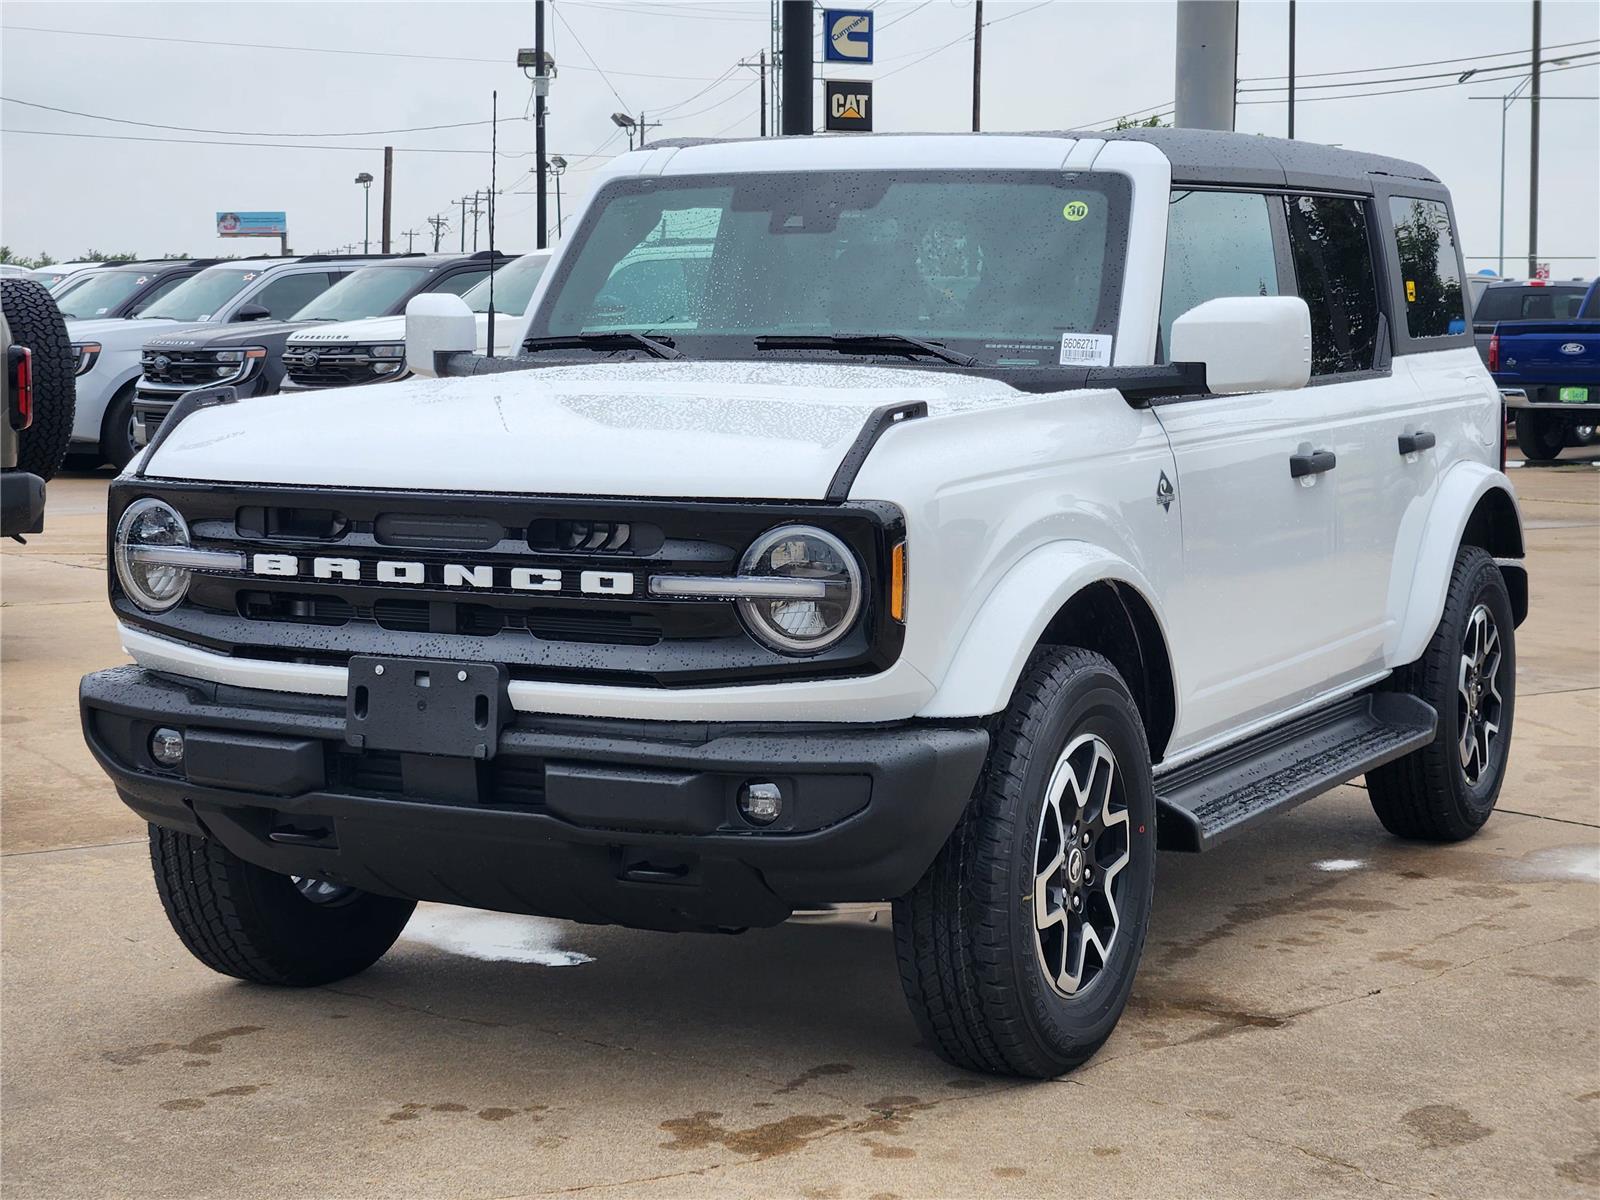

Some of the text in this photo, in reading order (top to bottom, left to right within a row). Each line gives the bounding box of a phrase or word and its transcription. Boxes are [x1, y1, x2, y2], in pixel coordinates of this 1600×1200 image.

[832, 16, 866, 41] Cummins
[831, 93, 869, 119] CAT
[1068, 205, 1085, 217] 30
[1063, 339, 1099, 350] 6606271T
[253, 553, 634, 595] BRONCO
